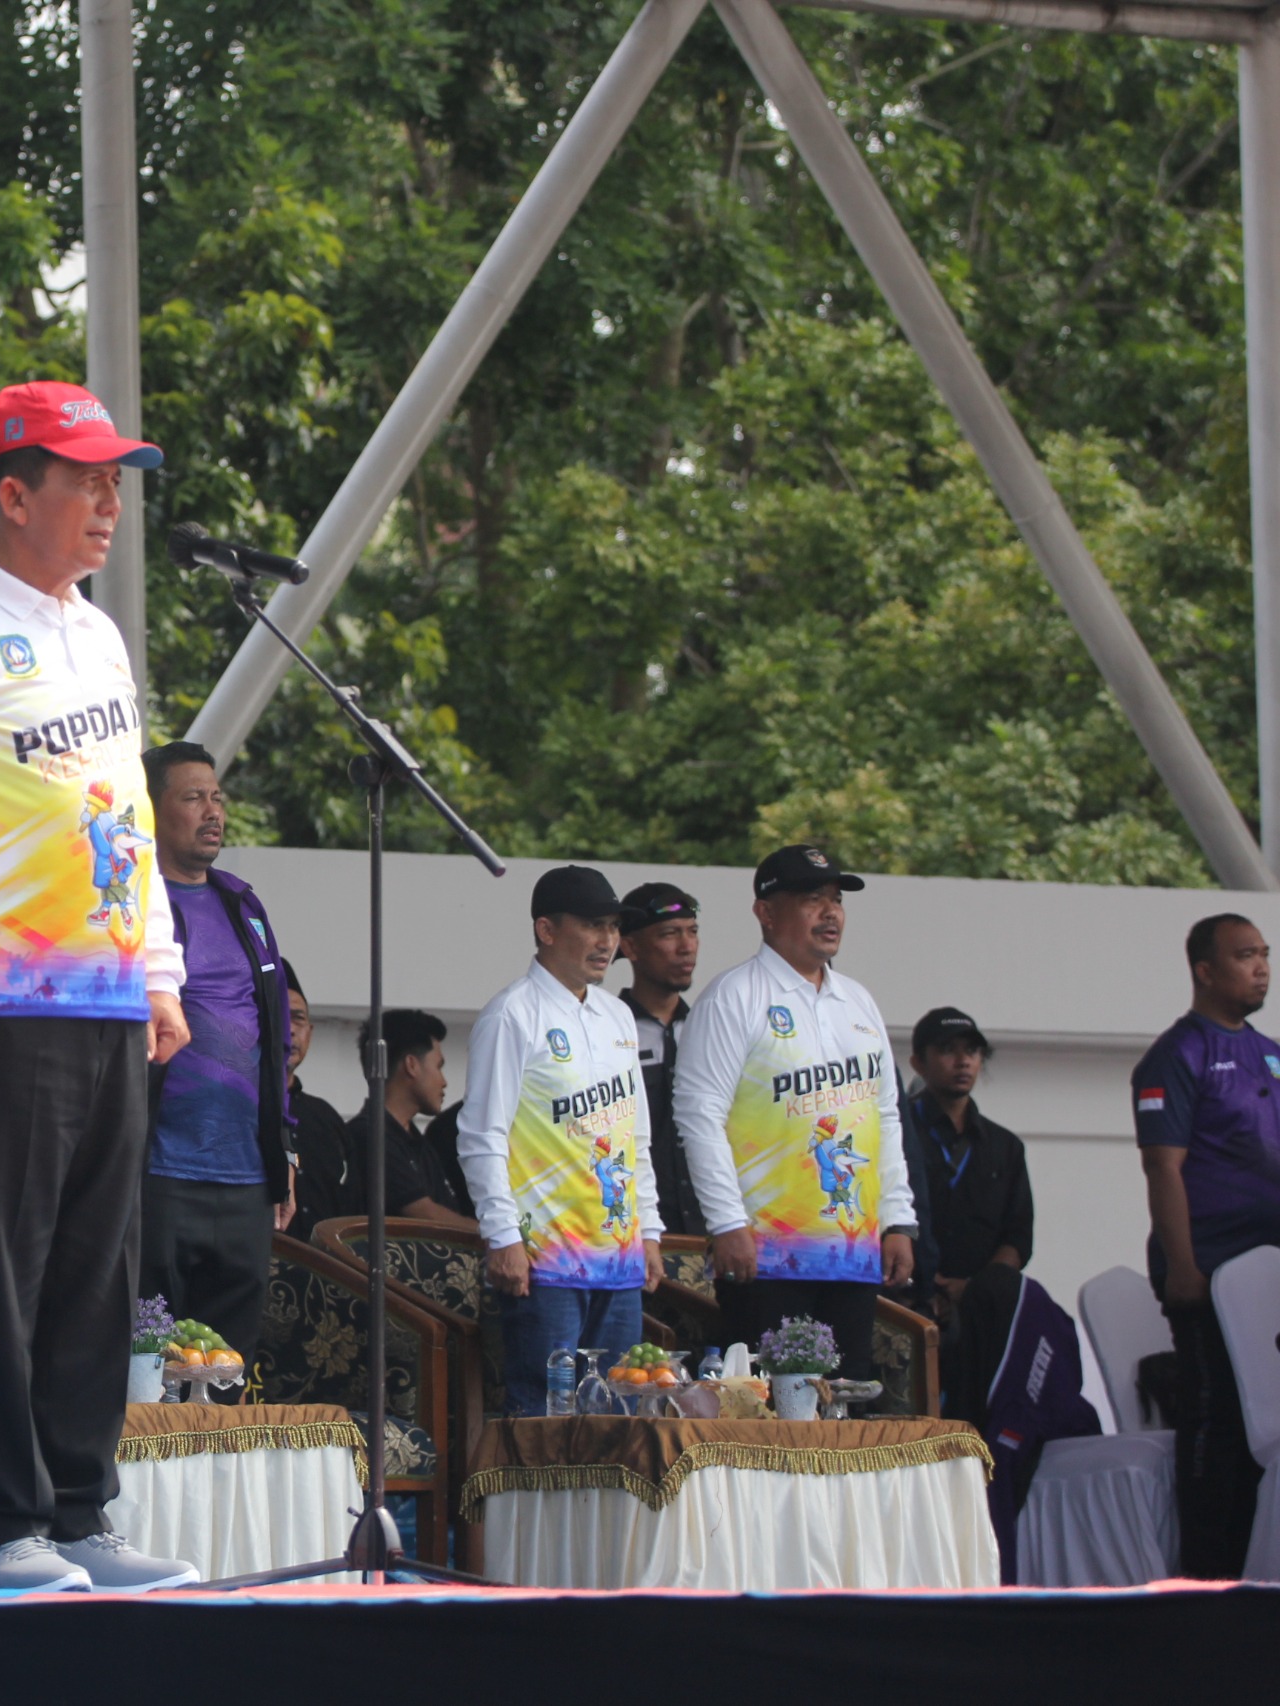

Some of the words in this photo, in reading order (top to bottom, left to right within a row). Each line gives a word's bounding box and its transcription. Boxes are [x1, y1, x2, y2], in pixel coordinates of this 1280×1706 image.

[5, 416, 25, 442] FJ
[12, 697, 128, 764] POPDA
[552, 1073, 626, 1124] POPDA
[773, 1055, 862, 1103] POPDA
[867, 1050, 884, 1079] IX
[786, 1090, 845, 1118] KEPRI
[848, 1080, 878, 1103] 2024
